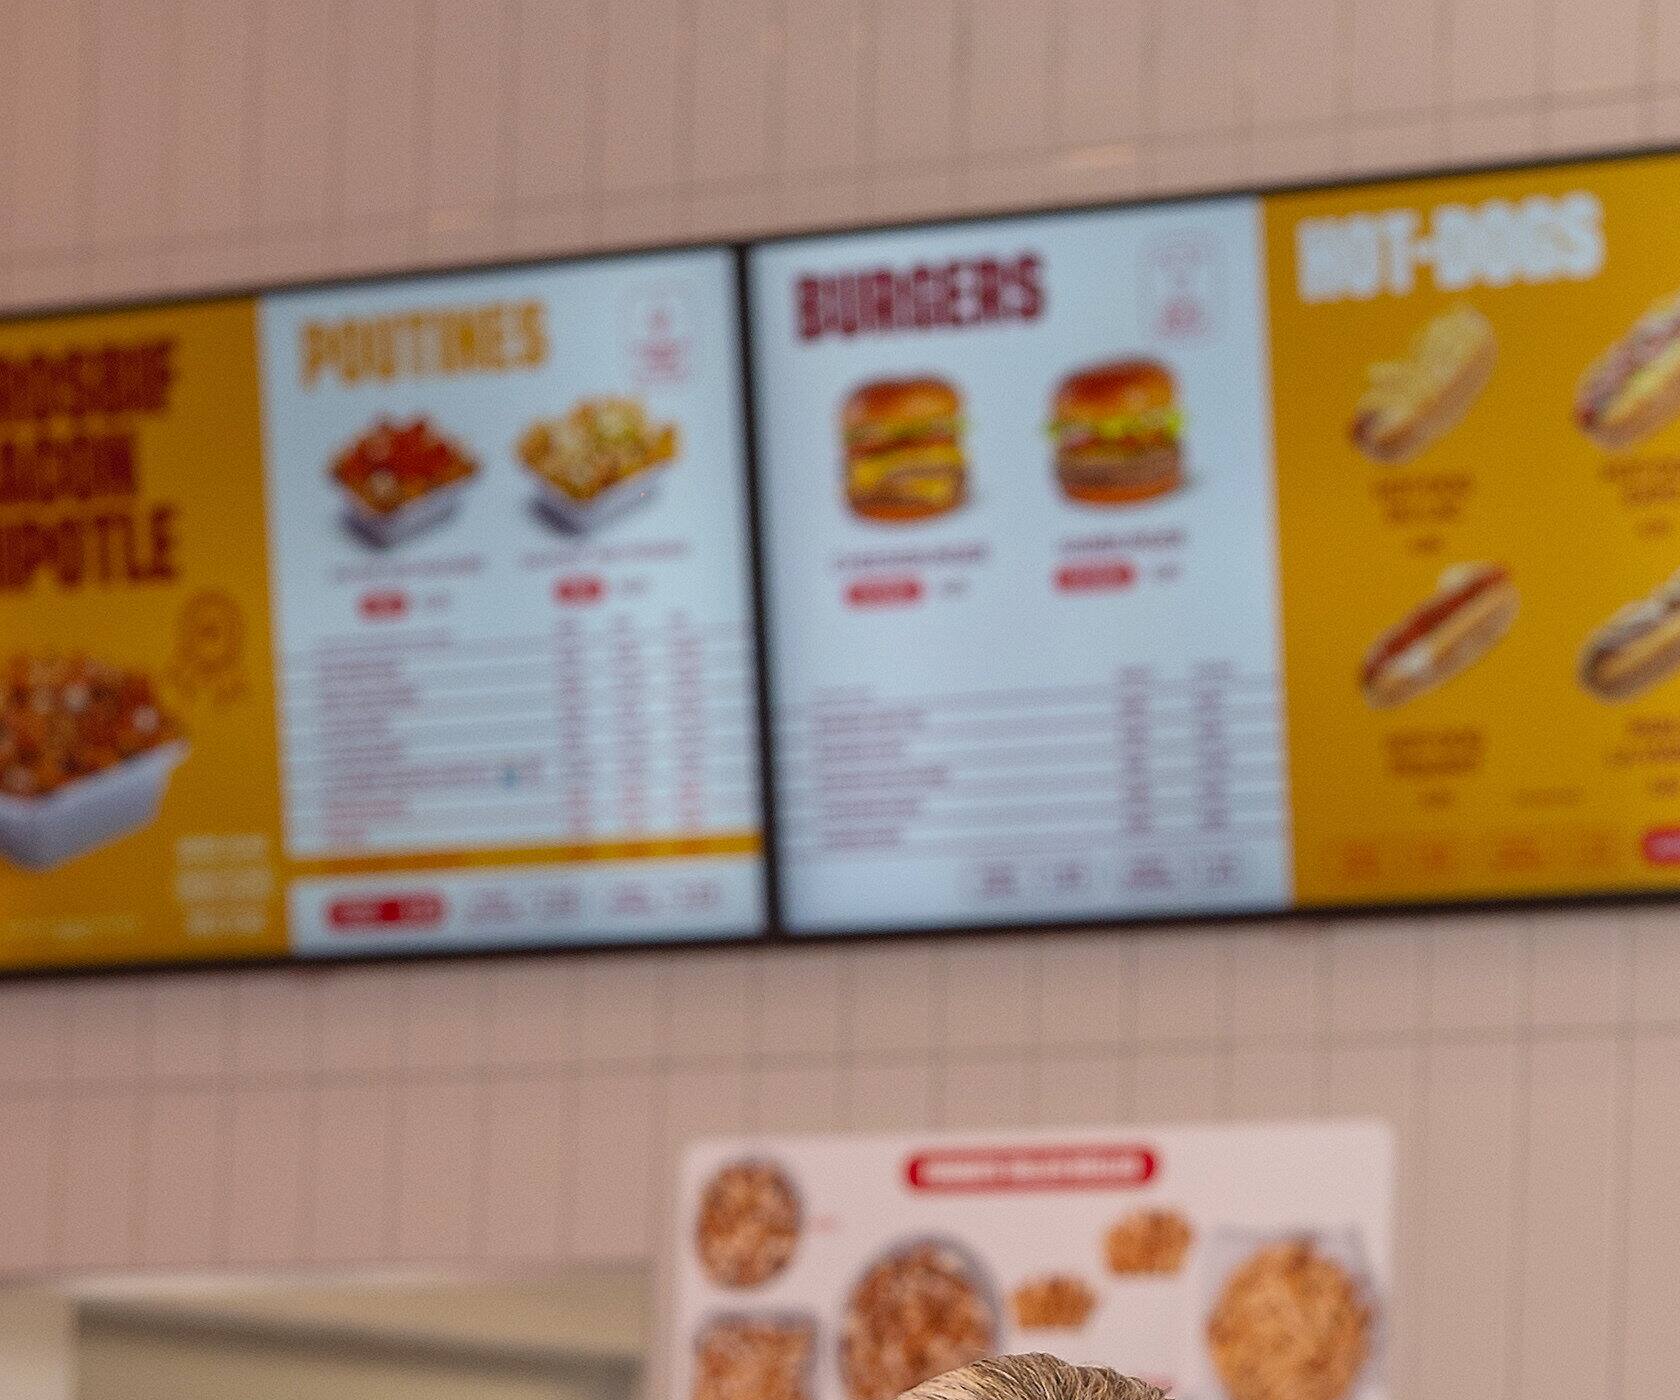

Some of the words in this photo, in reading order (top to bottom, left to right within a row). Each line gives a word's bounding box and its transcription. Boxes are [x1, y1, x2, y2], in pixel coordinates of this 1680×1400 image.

[1298, 193, 1603, 301] HOT-DOGS
[299, 299, 551, 390] POUTINES
[794, 250, 1048, 345] BURGERS
